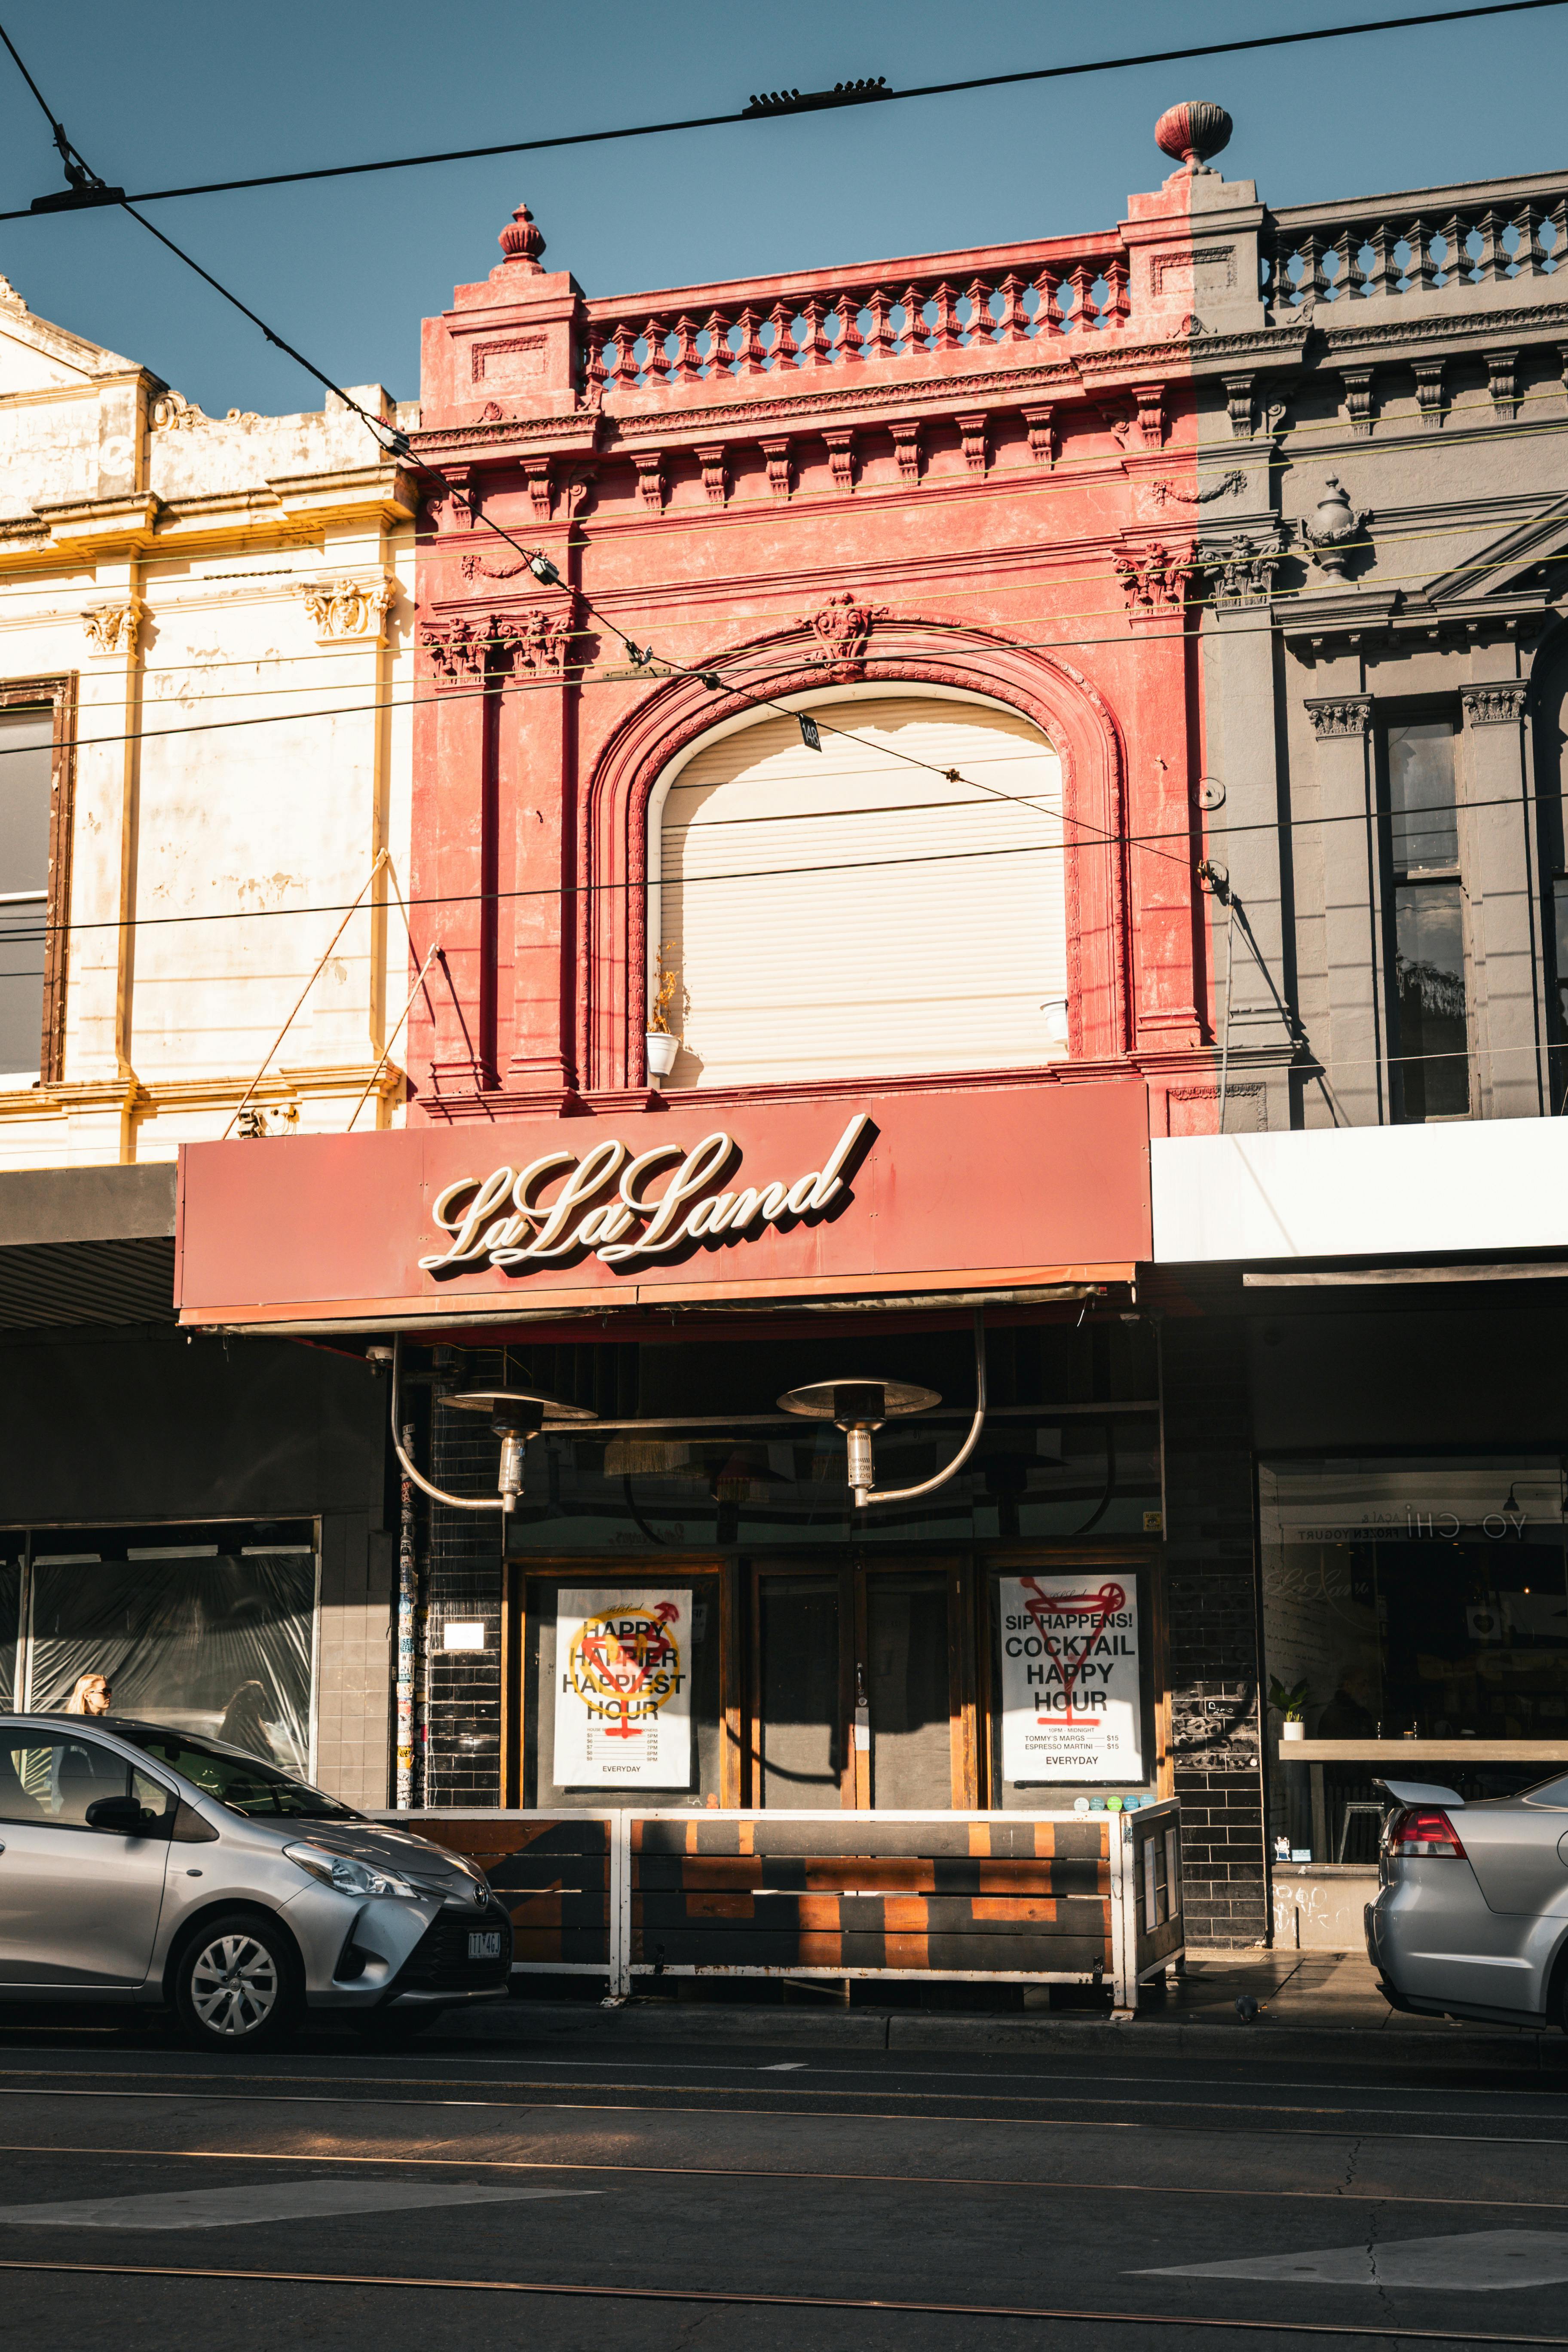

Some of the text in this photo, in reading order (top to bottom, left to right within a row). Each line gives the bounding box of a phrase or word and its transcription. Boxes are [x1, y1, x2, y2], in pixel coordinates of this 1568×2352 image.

[584, 1621, 668, 1641] HAPPY
[1005, 1613, 1133, 1630] SIP HAPPENS!
[1005, 1635, 1135, 1658] COCKTAIL
[570, 1648, 680, 1667] HAPPIER
[1026, 1663, 1114, 1684] HAPPY
[563, 1674, 686, 1694] HAPPIEST
[587, 1701, 659, 1721] HOUR
[1035, 1691, 1108, 1712] HOUR
[1045, 1756, 1099, 1765] EVERYDAY
[487, 1935, 499, 1953] 4GJ
